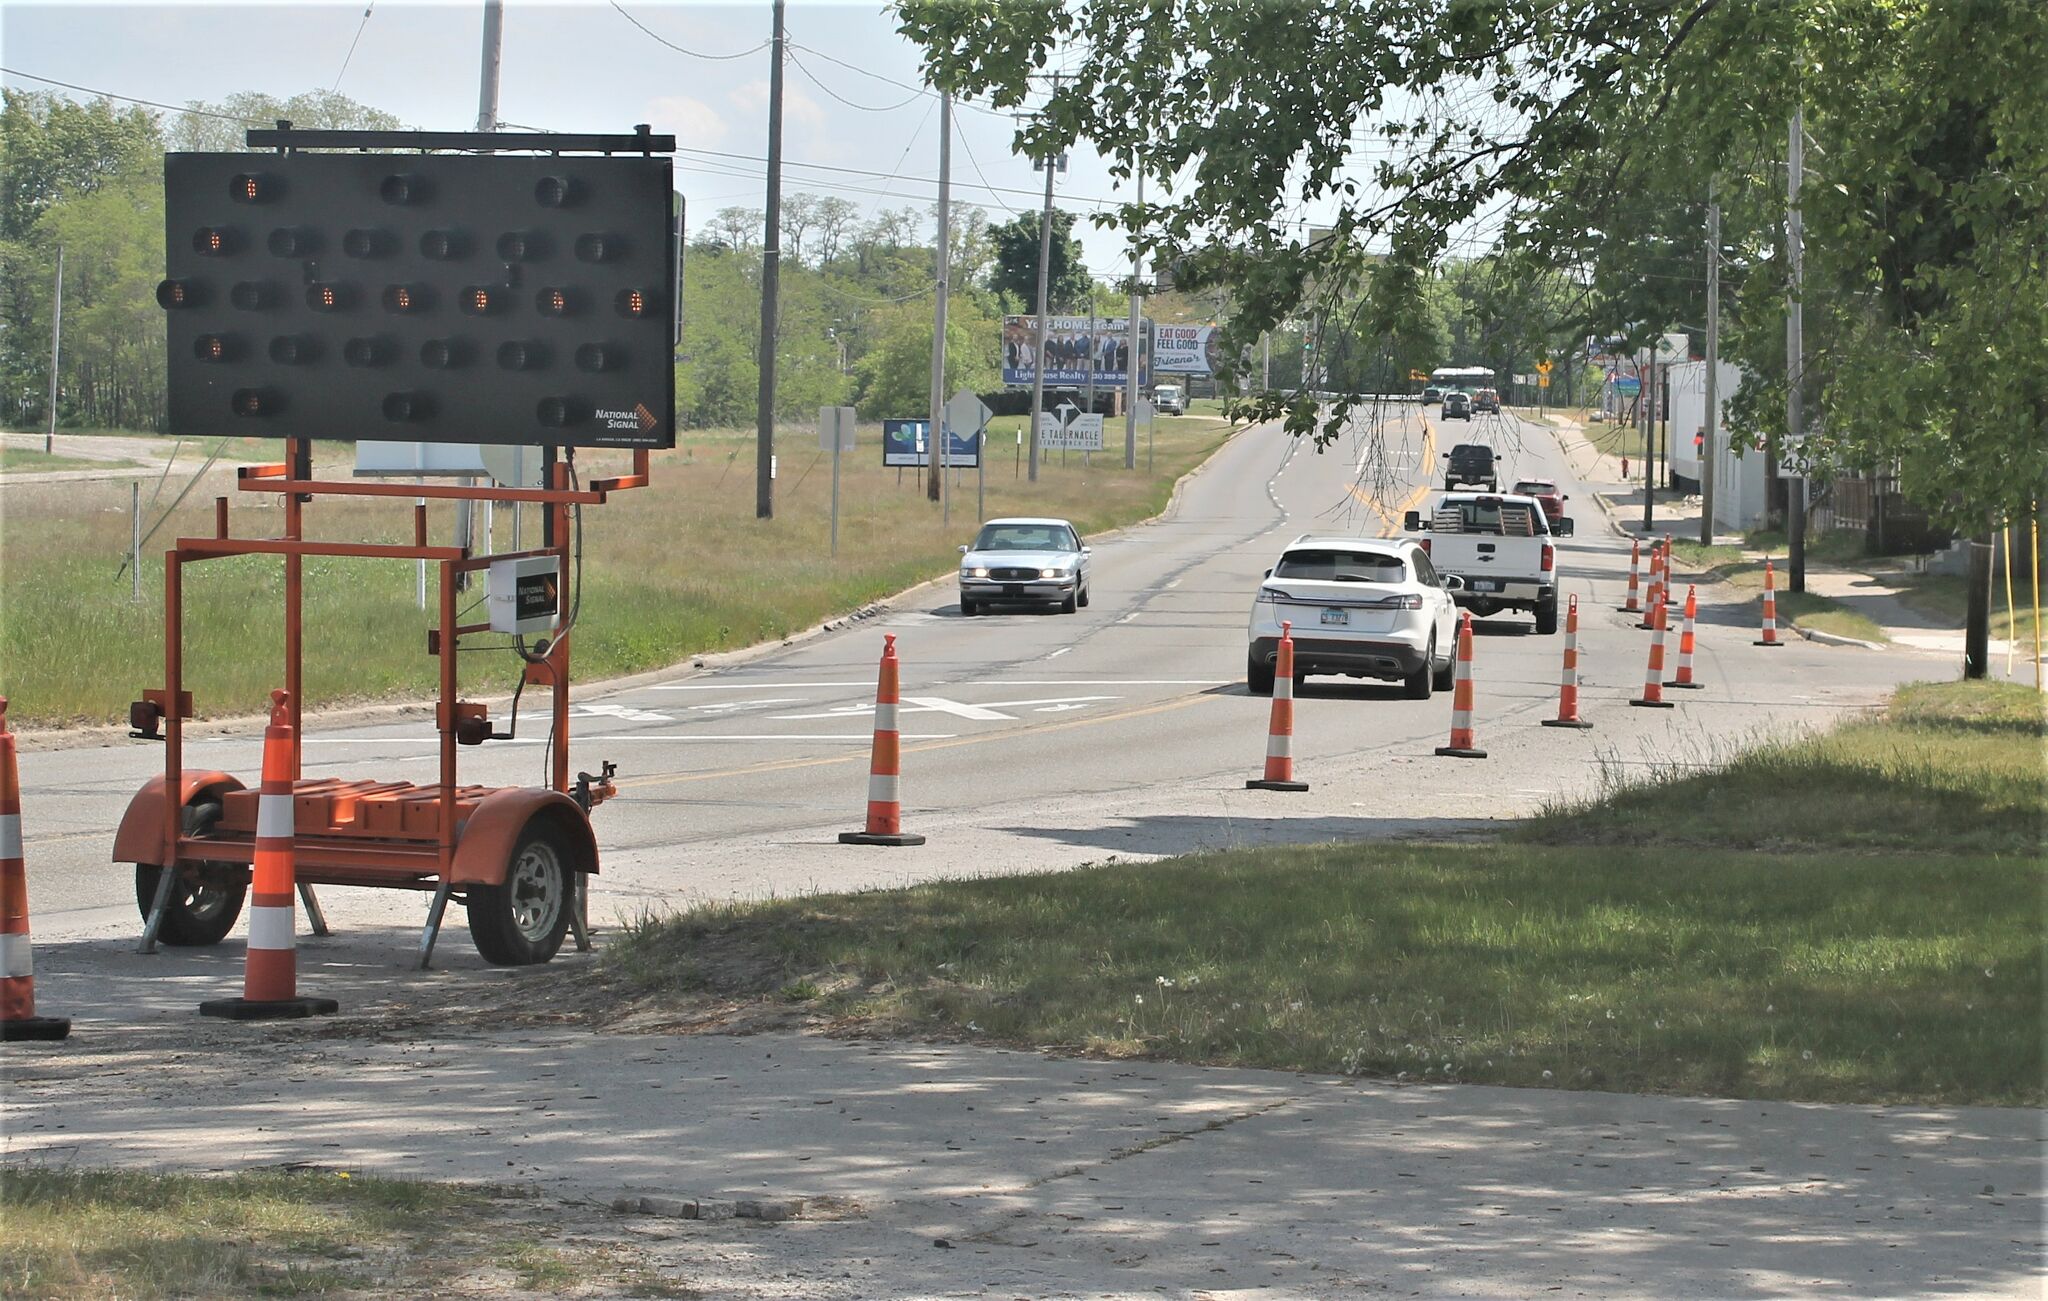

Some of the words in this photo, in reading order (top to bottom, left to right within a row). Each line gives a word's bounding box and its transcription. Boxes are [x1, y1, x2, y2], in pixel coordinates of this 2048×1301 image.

[1054, 319, 1091, 330] HOME
[1093, 319, 1124, 331] Team
[1160, 328, 1173, 338] EAT
[1175, 328, 1196, 339] GOOD
[1157, 339, 1174, 349] FEEL
[1176, 339, 1198, 350] GOOD
[1059, 371, 1085, 382] Realty
[595, 409, 639, 420] NATIONAL
[607, 419, 639, 429] SIGNAL
